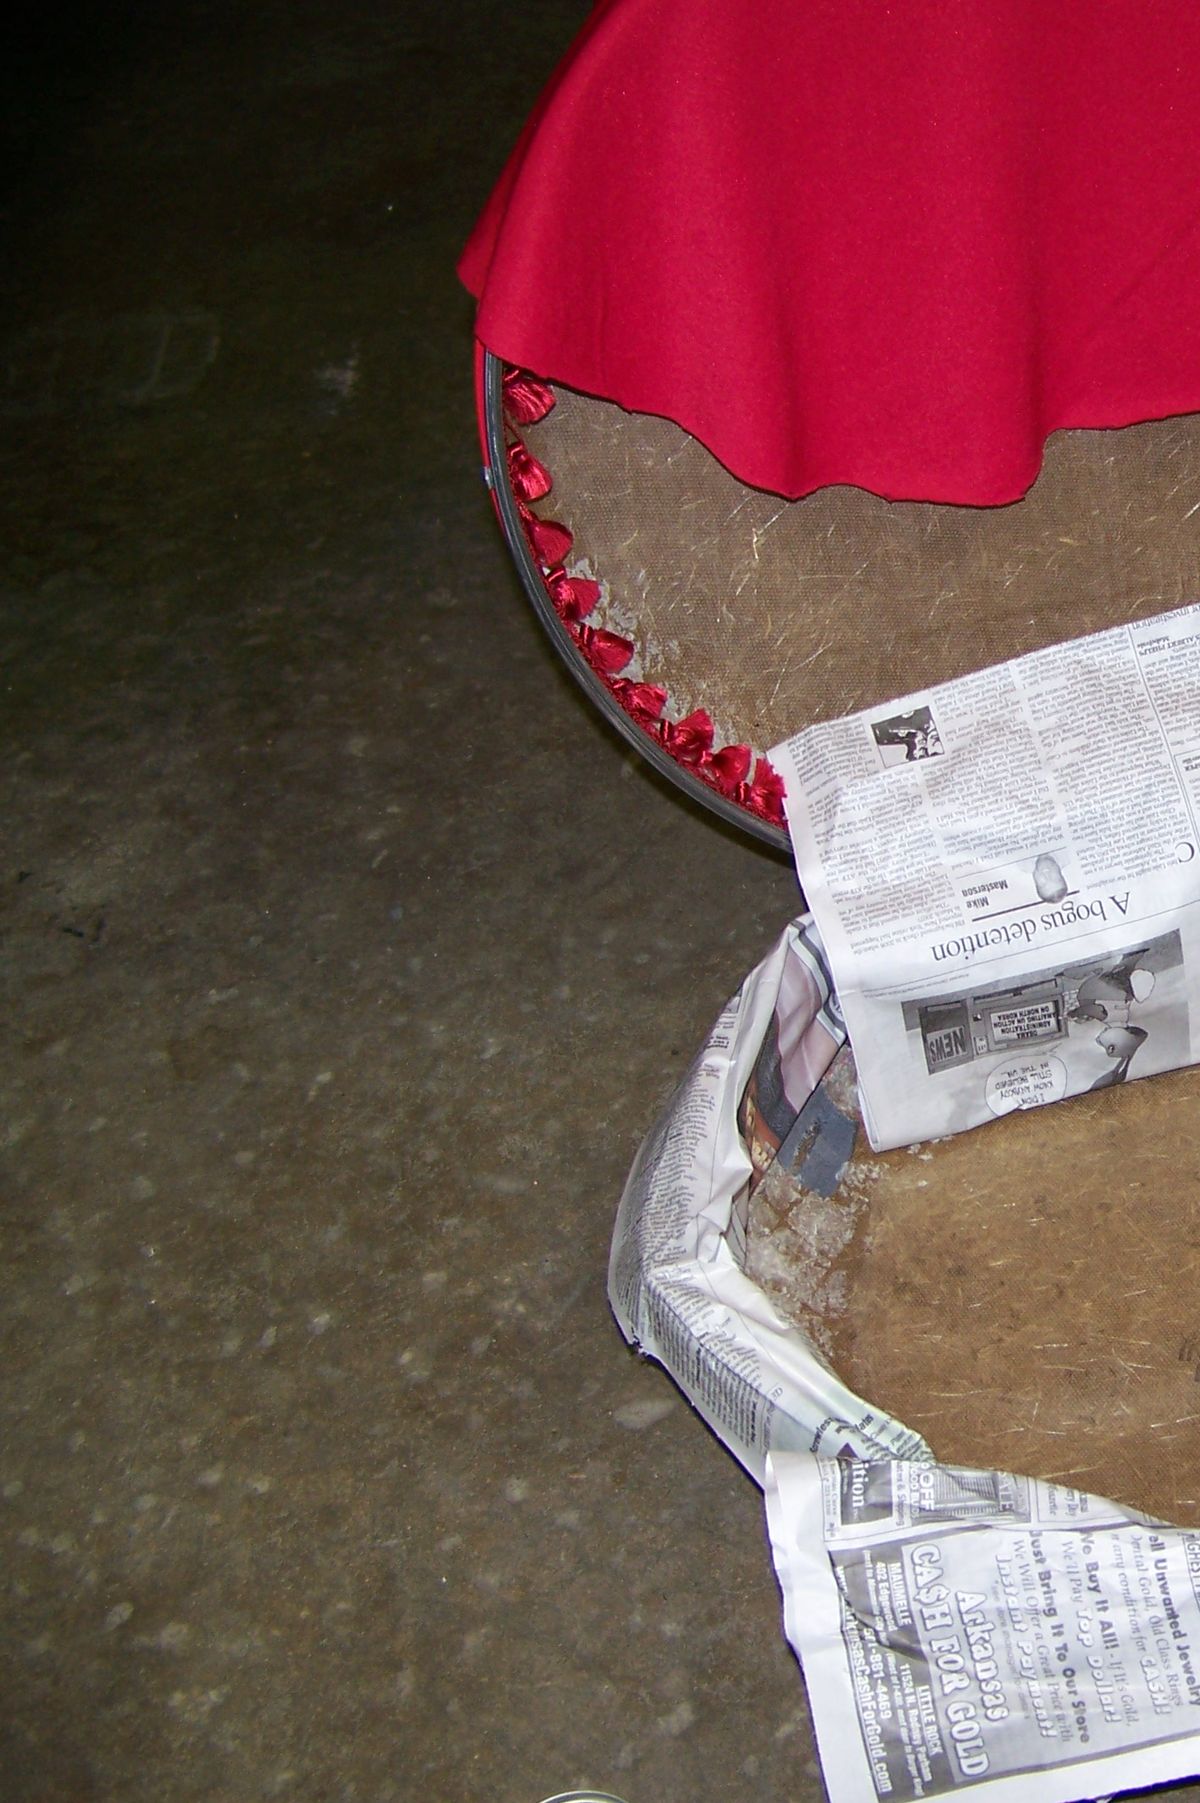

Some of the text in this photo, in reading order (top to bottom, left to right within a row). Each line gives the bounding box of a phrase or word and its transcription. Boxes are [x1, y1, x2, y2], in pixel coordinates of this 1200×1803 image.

[1131, 607, 1190, 631] investigation
[1138, 643, 1165, 656] PHELPS
[961, 878, 1008, 899] Masterson
[965, 895, 989, 910] Mike
[930, 891, 1135, 967] A bogus detention
[993, 1017, 1015, 1030] ACTION
[997, 1011, 1018, 1022] KOREA
[1000, 1019, 1051, 1039] ADMINISTRATION
[928, 1027, 967, 1063] NEWS
[1019, 1064, 1035, 1074] THE
[1029, 1068, 1052, 1081] STILL
[918, 1472, 936, 1511] OFF
[1011, 1540, 1027, 1561] We
[875, 1560, 897, 1631] 402 Edgewood
[888, 1561, 912, 1625] MAUMELLE
[1017, 1563, 1035, 1592] Will
[1136, 1575, 1157, 1612] Gold,
[1023, 1594, 1045, 1629] Offer
[1152, 1557, 1184, 1640] Unwanted
[1026, 1528, 1094, 1744] Just Bring It To Our Store
[1059, 1540, 1121, 1725] We'll Pay Top Dollar!
[1109, 1542, 1168, 1717] any condition for CASH!
[1147, 1614, 1165, 1637] Old
[900, 1541, 992, 1778] CA$H FOR GOLD
[952, 1584, 1018, 1723] Arkansas
[994, 1551, 1030, 1634] Instant
[1013, 1640, 1057, 1741] Payment!
[1036, 1643, 1056, 1679] Great
[1082, 1561, 1103, 1595] Buy
[1098, 1618, 1119, 1651] All!
[1117, 1692, 1139, 1727] Gold,
[1155, 1637, 1174, 1670] Class
[1046, 1680, 1065, 1711] Price
[1164, 1672, 1185, 1708] Rings
[899, 1663, 913, 1694] 11524
[916, 1745, 931, 1782] Parham
[917, 1684, 942, 1755] LITTLE ROCK
[1055, 1711, 1075, 1743] with
